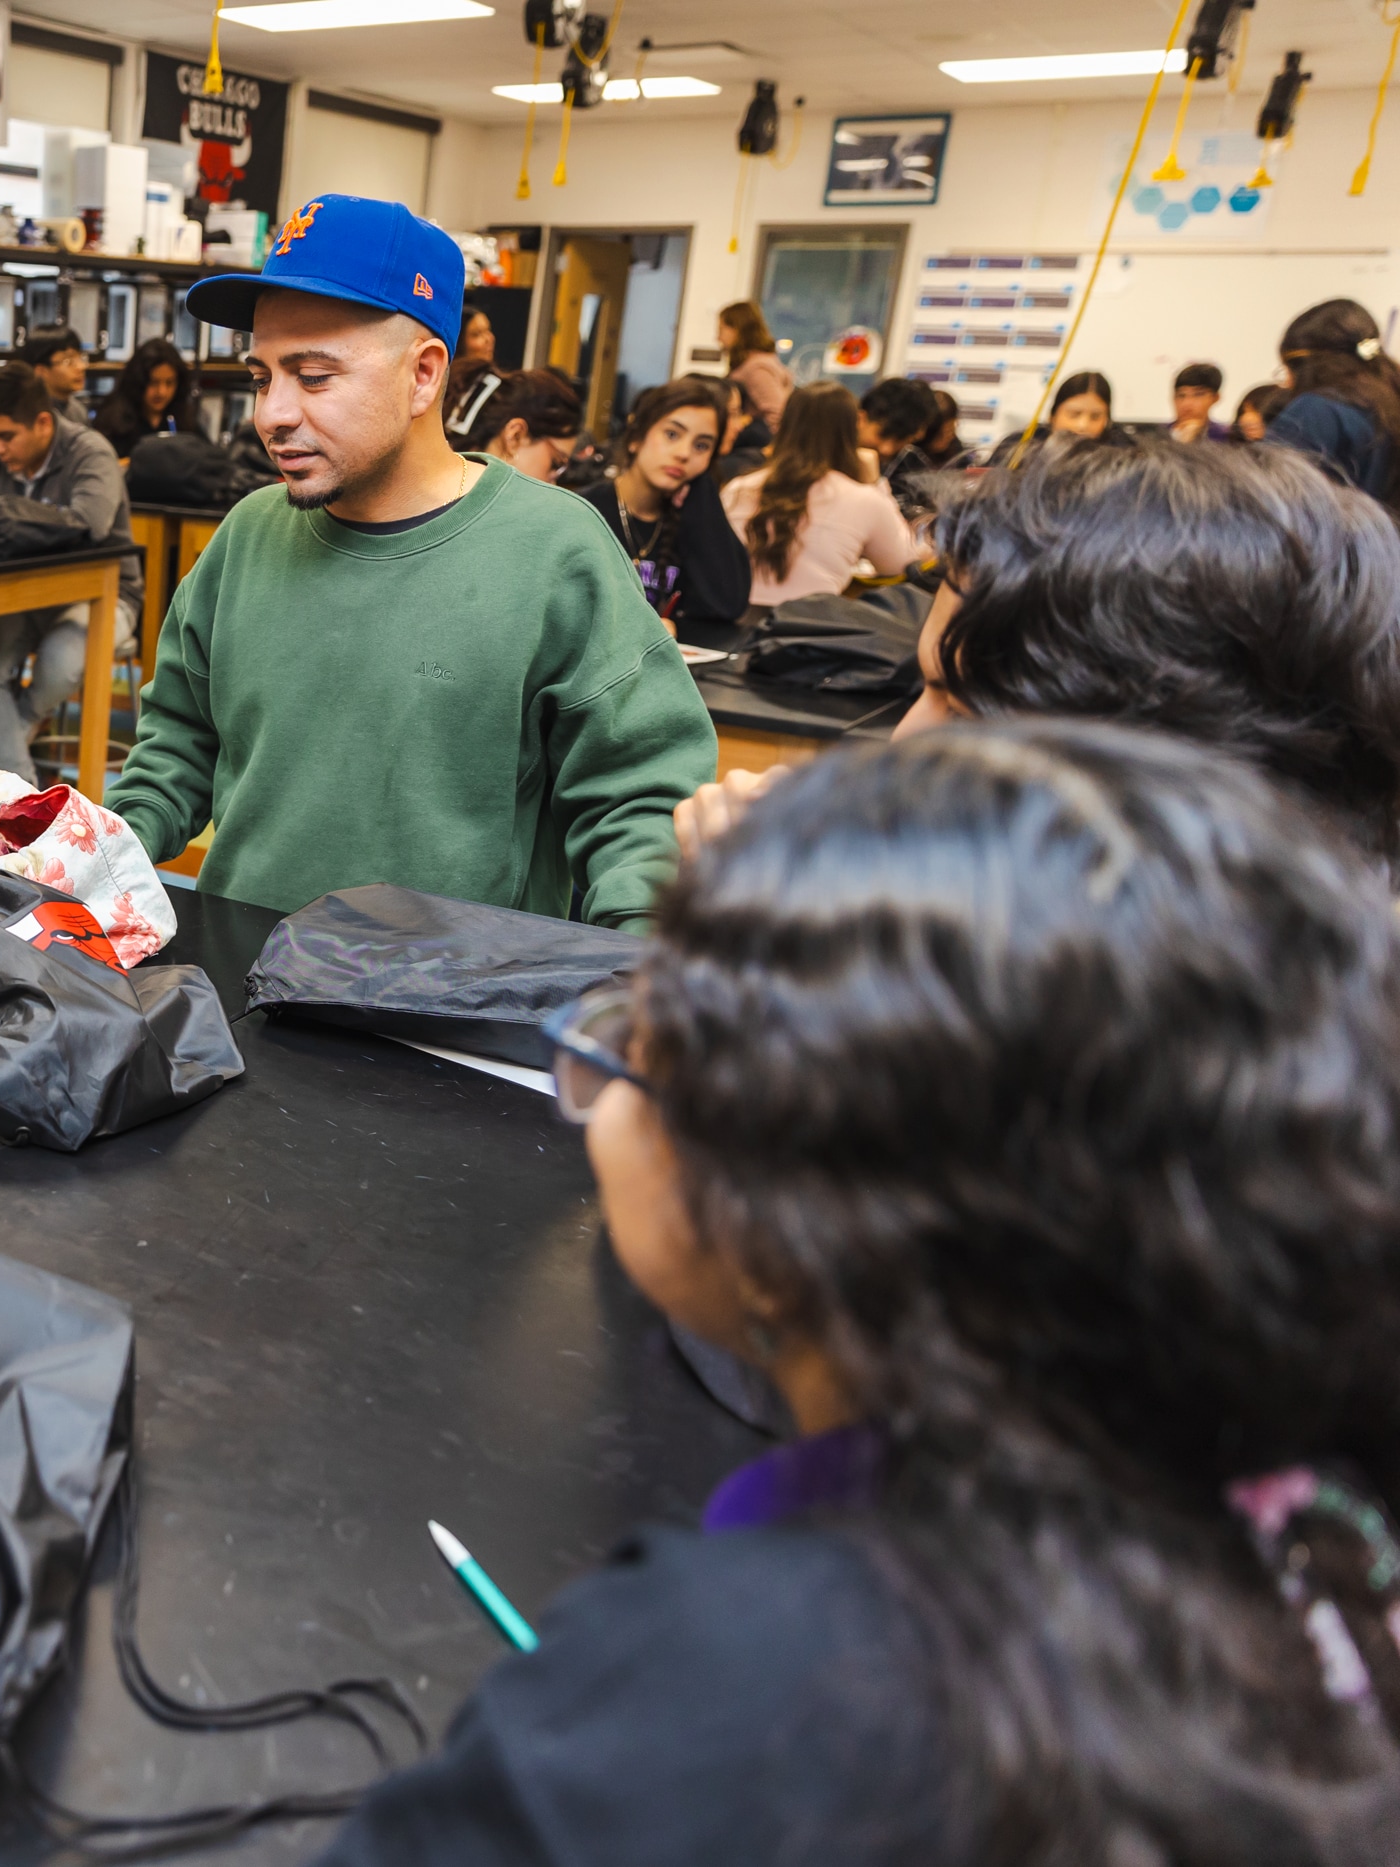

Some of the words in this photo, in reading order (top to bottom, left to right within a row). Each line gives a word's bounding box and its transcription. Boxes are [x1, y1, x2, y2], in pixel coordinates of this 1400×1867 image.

[176, 64, 261, 110] CHAGO
[188, 99, 248, 139] BULLS
[15, 325, 27, 348] 2
